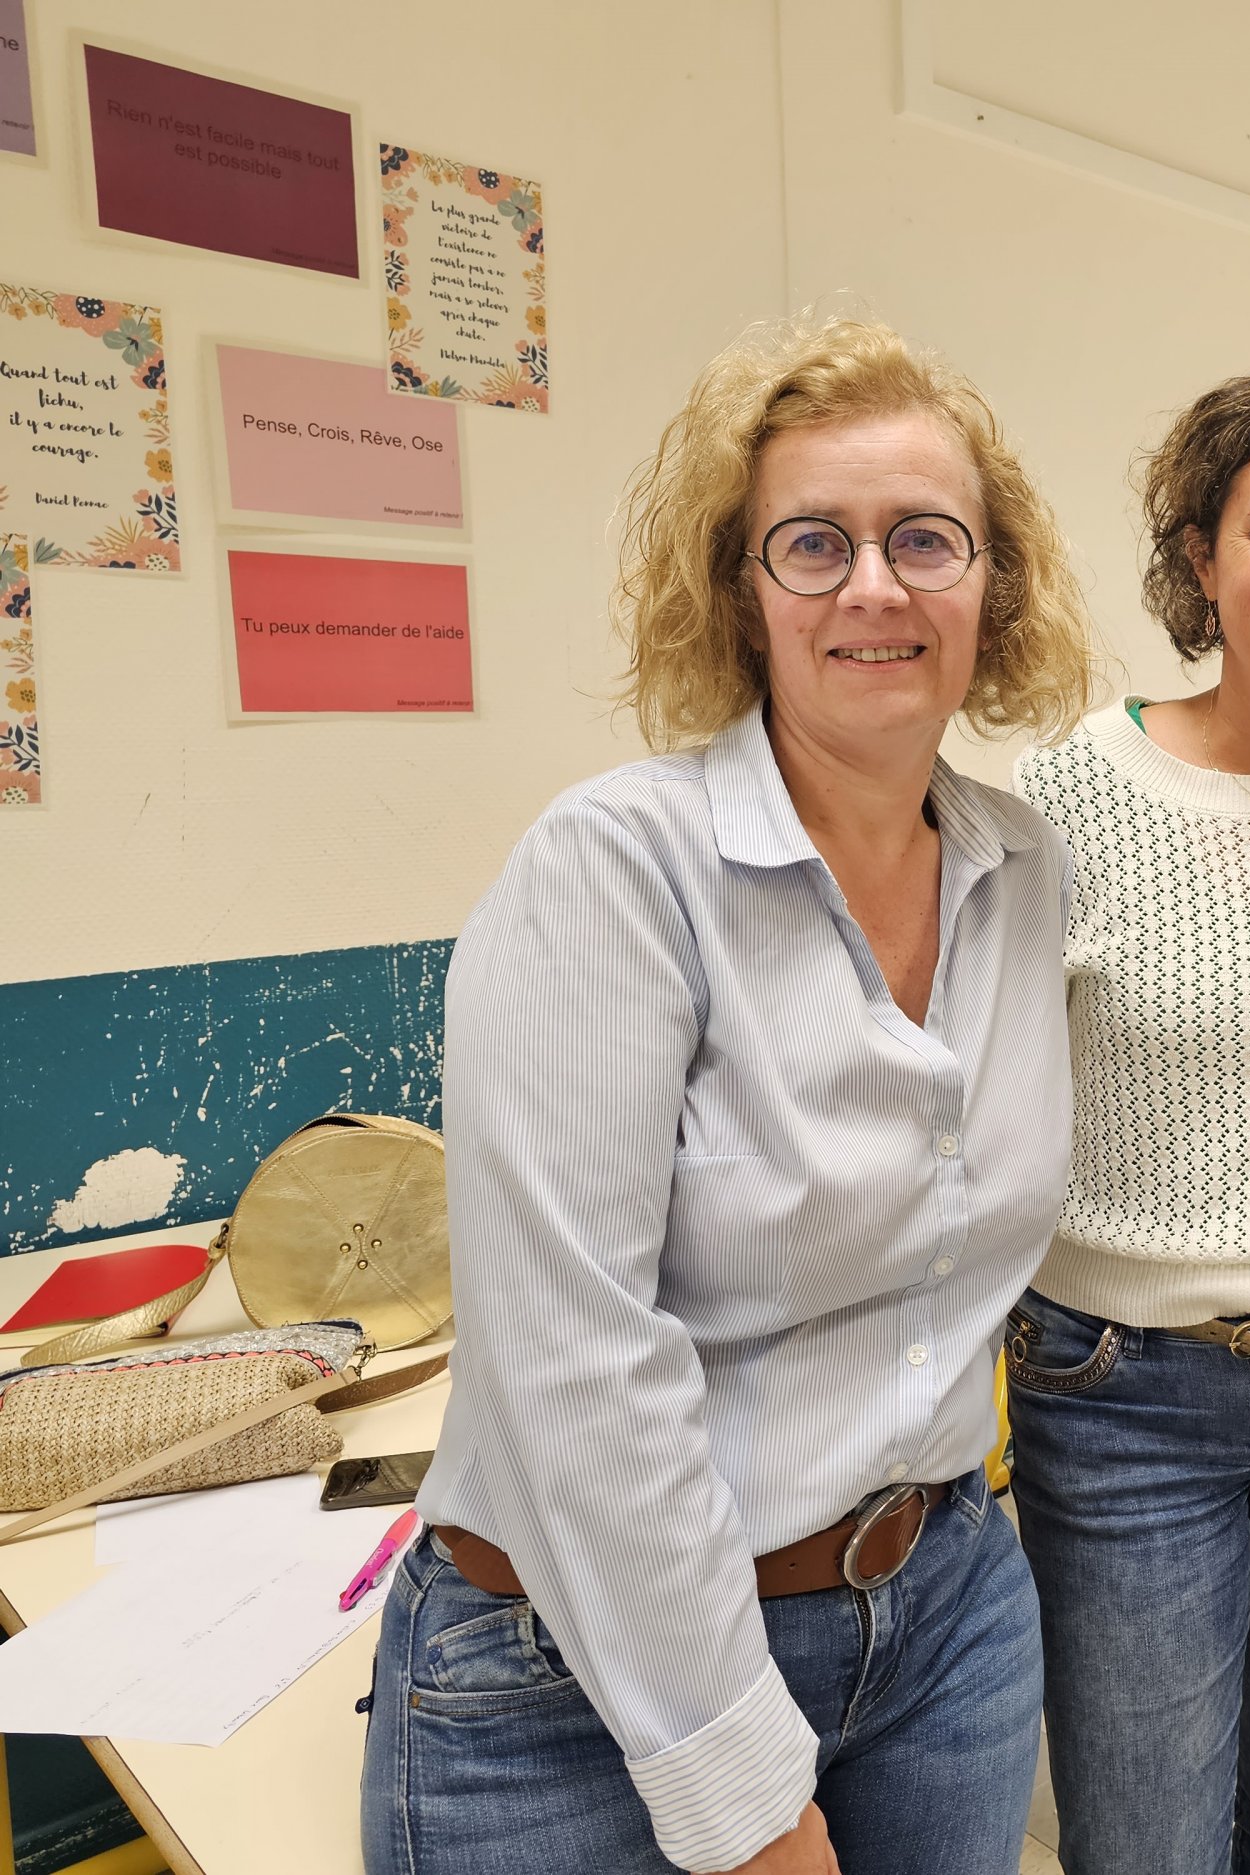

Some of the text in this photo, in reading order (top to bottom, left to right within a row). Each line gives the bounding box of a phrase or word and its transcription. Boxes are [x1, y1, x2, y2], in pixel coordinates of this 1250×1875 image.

[107, 99, 341, 172] Rien n'est facile mais tout
[174, 142, 283, 180] est possible
[431, 199, 501, 225] La plus grande
[442, 223, 492, 241] victoire de
[438, 235, 498, 259] l'existence ne
[430, 257, 467, 269] consiste
[469, 263, 485, 275] pas
[496, 269, 507, 278] ne
[430, 271, 465, 287] jamais
[429, 290, 453, 303] mais
[464, 296, 475, 306] se
[477, 297, 509, 314] relever
[467, 311, 501, 329] chaque
[456, 326, 486, 342] chute.
[440, 348, 506, 369] Nelson Mandela
[0, 360, 120, 391] Quand tout est
[38, 387, 84, 411] fichu,
[9, 411, 125, 437] il y a encore le
[242, 413, 444, 453] Pense, Crois, Rêve, Ose
[32, 444, 99, 464] courage.
[35, 491, 110, 509] Daniel Pennac
[383, 505, 413, 516] Message
[241, 617, 465, 640] Tu peux demander de l'aide
